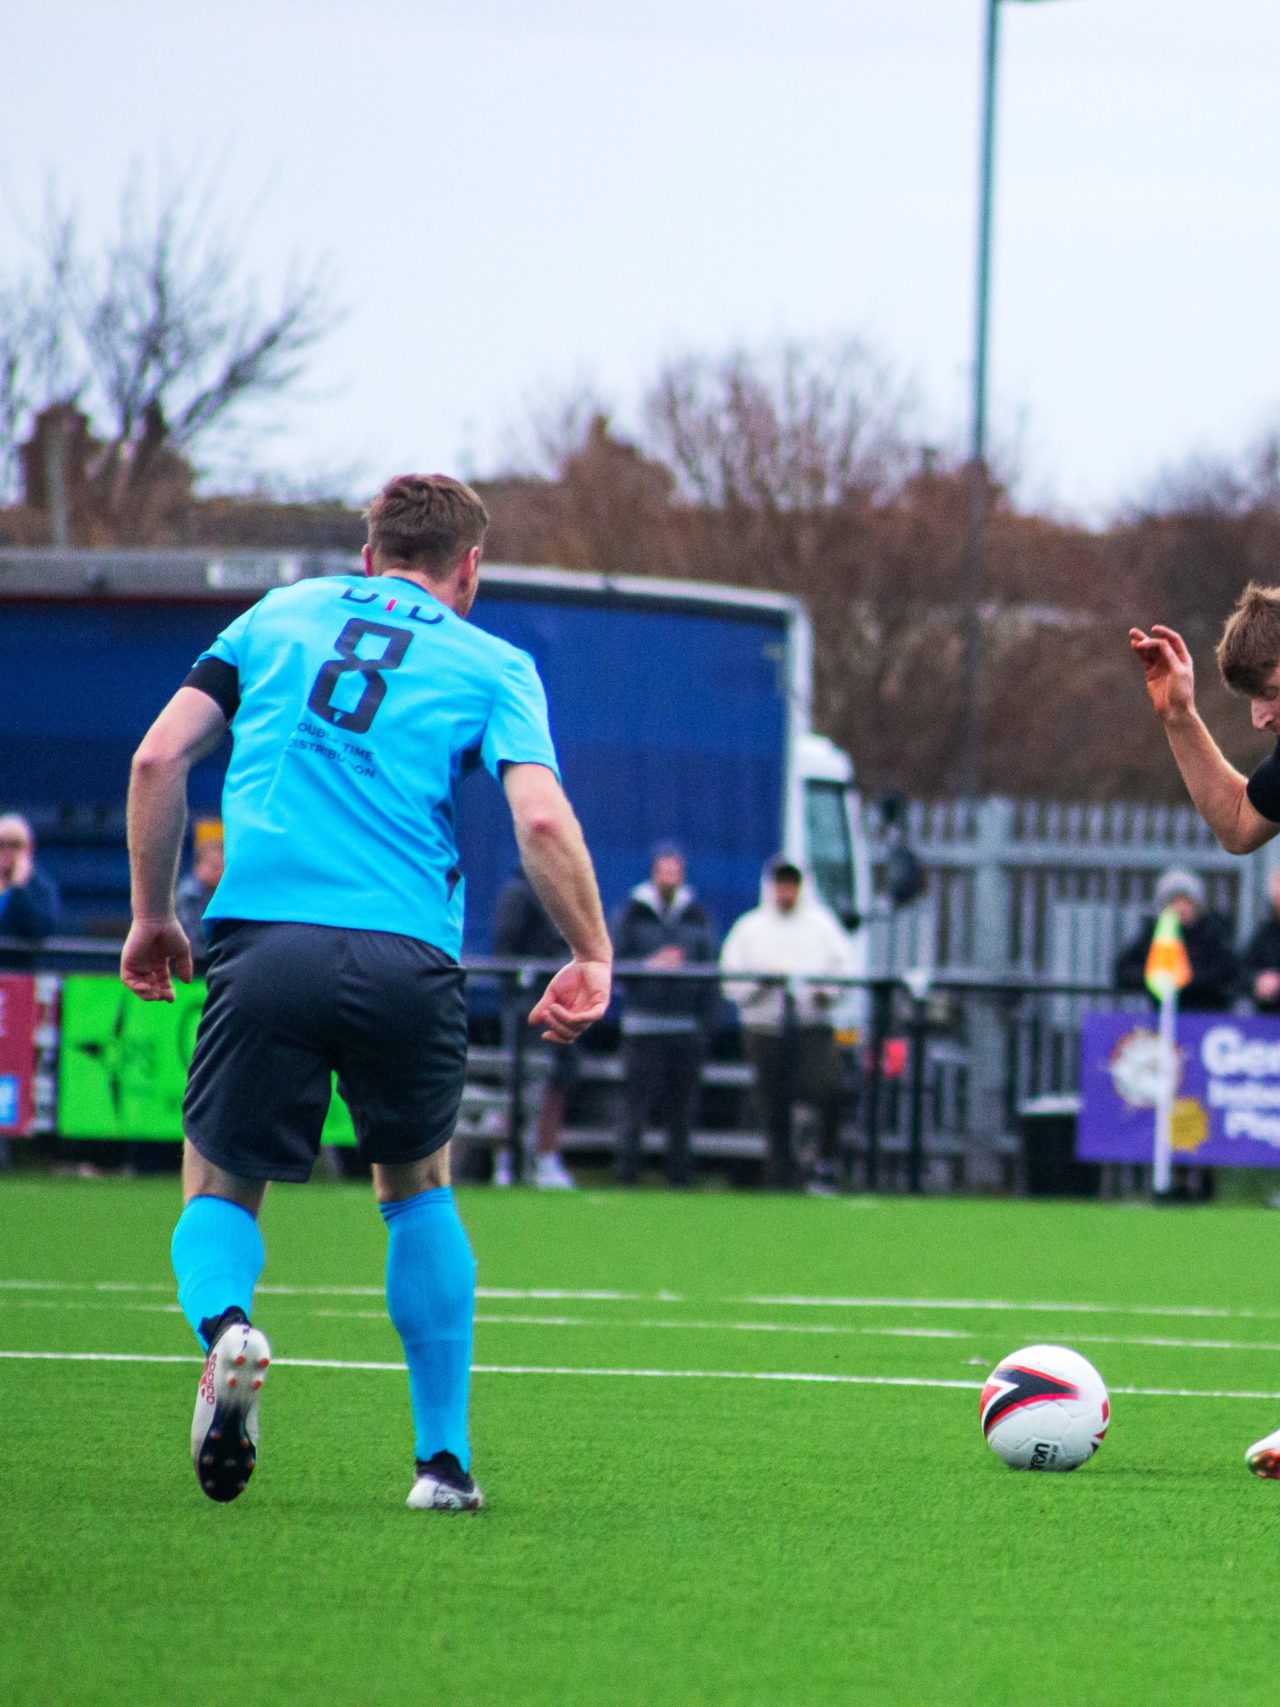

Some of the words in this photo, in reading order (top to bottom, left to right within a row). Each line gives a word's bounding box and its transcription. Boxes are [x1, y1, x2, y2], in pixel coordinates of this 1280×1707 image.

[306, 617, 414, 734] 8
[343, 743, 373, 763] TIME
[206, 1353, 216, 1405] adidas
